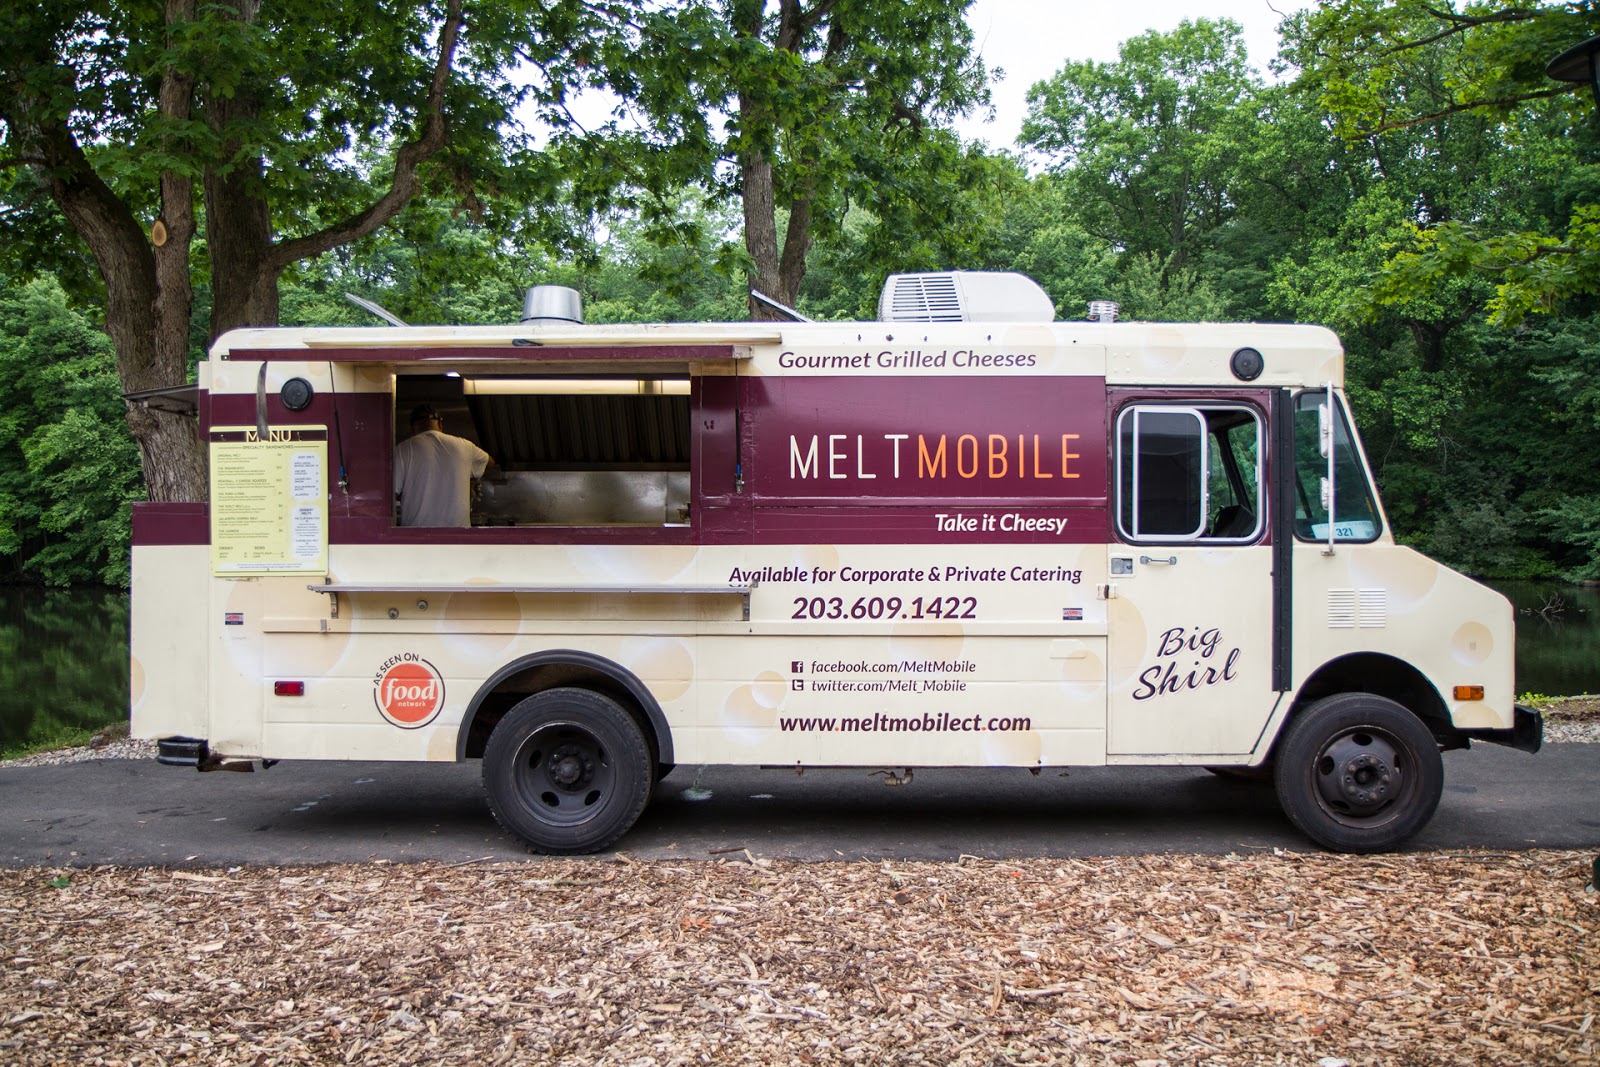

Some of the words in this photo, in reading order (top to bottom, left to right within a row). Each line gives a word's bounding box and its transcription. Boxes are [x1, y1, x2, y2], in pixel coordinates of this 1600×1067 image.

[778, 351, 872, 368] Gourmet
[876, 350, 947, 368] Grilled
[952, 349, 1037, 368] Cheeses
[246, 430, 292, 442] MNU
[934, 513, 978, 532] Take
[981, 513, 997, 532] it
[999, 513, 1068, 535] Cheesy
[1335, 527, 1354, 537] 321
[729, 566, 809, 582] Available
[811, 566, 837, 585] for
[839, 566, 925, 585] Corporate
[927, 566, 941, 582] &
[944, 565, 1007, 582] Private
[1009, 565, 1083, 585] Catering
[791, 596, 978, 620] 203.609.1422
[1157, 626, 1223, 658] Big
[374, 672, 383, 686] AS
[380, 654, 402, 673] SEEN
[404, 652, 419, 661] ON
[811, 660, 977, 675] facebook.com/MeltMobile
[1132, 647, 1240, 701] Shirl
[386, 677, 436, 708] food
[812, 680, 967, 694] twitter.com/Melt_Mobile
[780, 712, 1031, 732] www.meltmobilect.com
